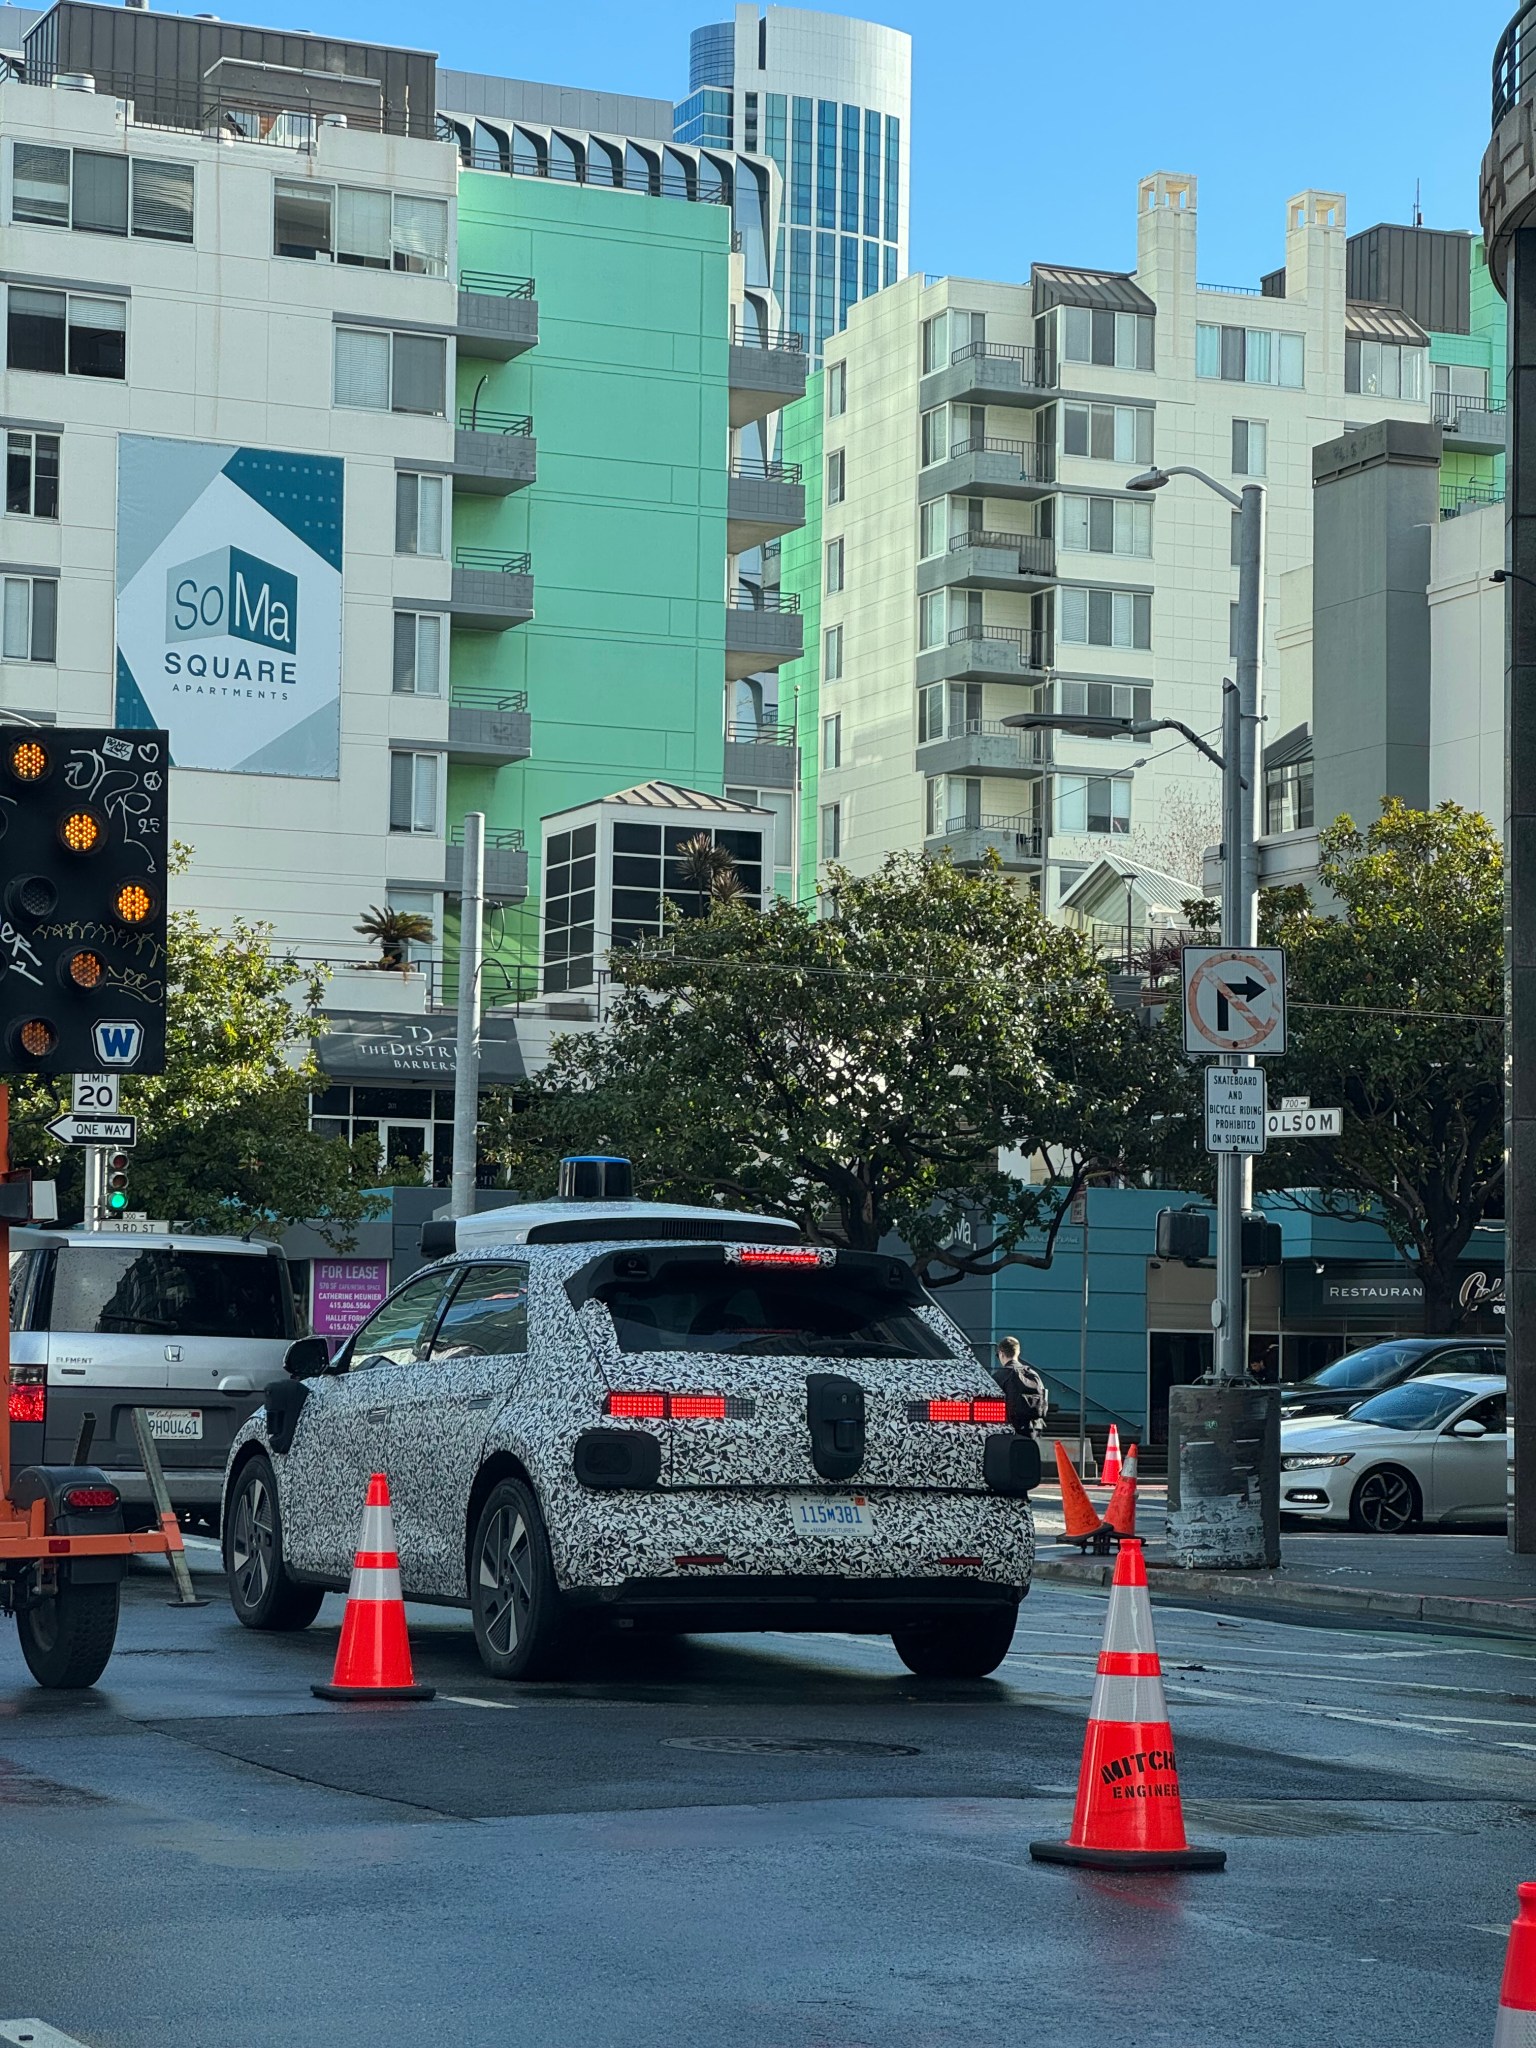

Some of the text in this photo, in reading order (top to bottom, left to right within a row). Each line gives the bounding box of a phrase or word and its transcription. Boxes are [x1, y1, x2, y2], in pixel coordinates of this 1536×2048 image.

[174, 571, 290, 643] SoMa
[164, 651, 297, 685] SQUARE
[172, 683, 289, 701] APARTMENTS
[100, 1028, 135, 1058] W
[394, 1059, 457, 1071] BARBERS
[81, 1073, 111, 1084] LIMIT
[1213, 1075, 1257, 1086] SKATEBOARD
[78, 1085, 113, 1107] 20
[1228, 1090, 1243, 1100] AND
[1285, 1099, 1299, 1108] 700
[1209, 1104, 1262, 1116] BICYCLE RIDING
[1215, 1119, 1256, 1130] PROHIBITED
[1268, 1113, 1333, 1133] OLSOM
[76, 1123, 128, 1136] ONE WAY
[1212, 1133, 1259, 1145] ON SIDEWALK
[124, 1212, 136, 1220] 300
[114, 1223, 156, 1233] 3RD ST
[321, 1265, 379, 1280] FOR LEASE
[318, 1292, 382, 1301] CATHERINE MEUNIER
[325, 1314, 367, 1322] HALLIE FORM
[800, 1505, 864, 1524] 115M381
[1101, 1750, 1178, 1785] MITCH
[1112, 1783, 1180, 1799] ENGINEE
